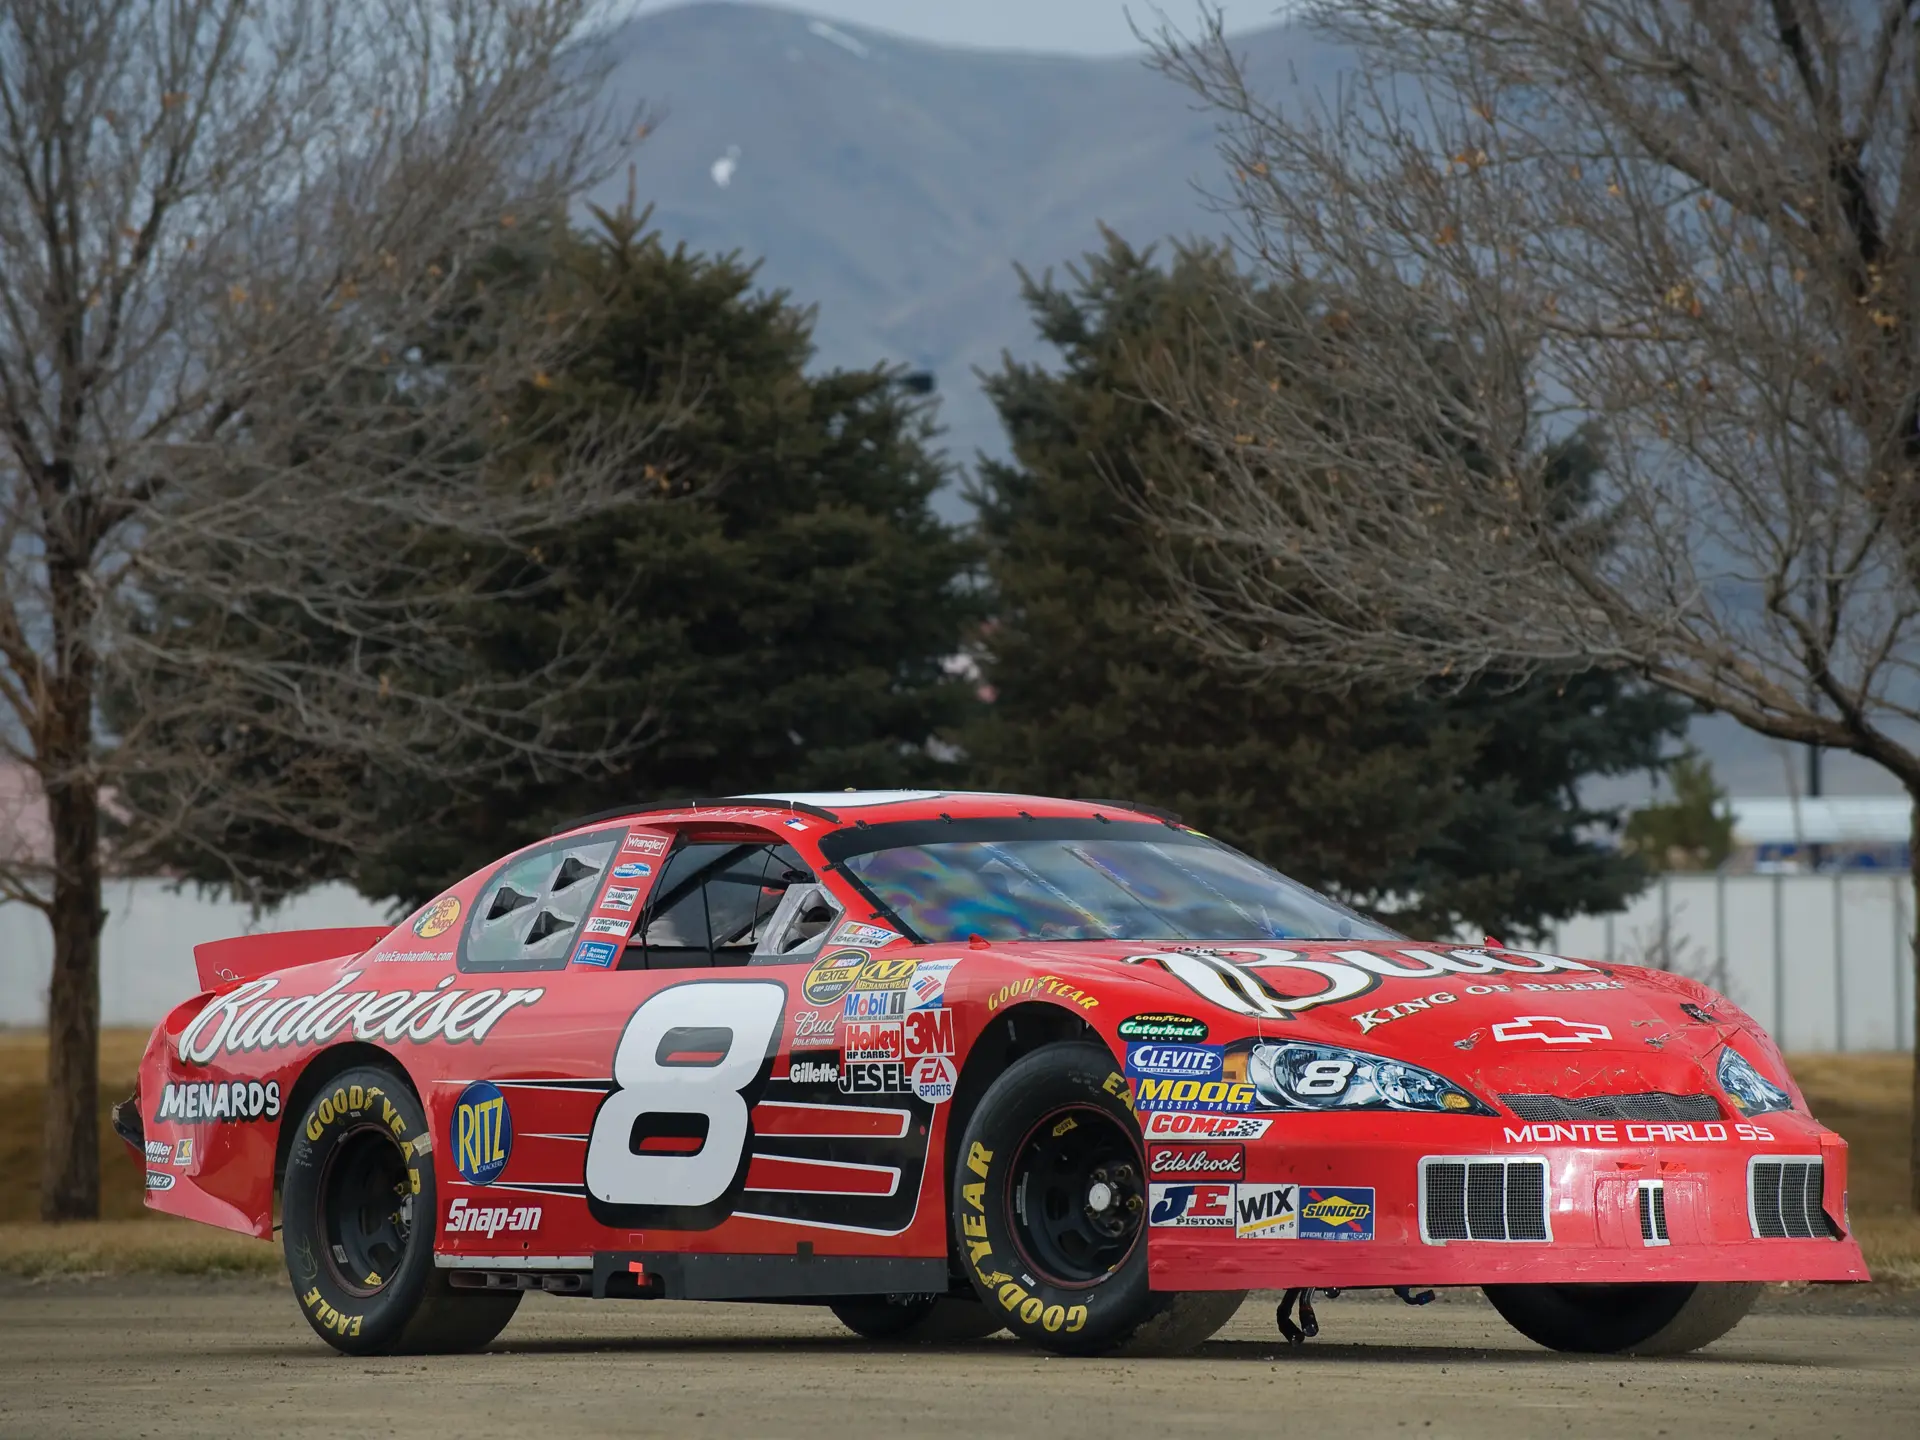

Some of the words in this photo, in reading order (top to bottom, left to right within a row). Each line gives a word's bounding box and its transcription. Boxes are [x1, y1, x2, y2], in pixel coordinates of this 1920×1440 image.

[628, 836, 664, 852] Wrangler
[608, 892, 635, 901] CHAMPION
[595, 918, 630, 929] CINCINNATI
[834, 935, 856, 943] RACE
[858, 937, 882, 946] CAR
[814, 968, 849, 983] NEXTEL
[855, 980, 889, 990] MECHANIX
[890, 978, 910, 988] WEAR
[1126, 946, 1606, 1019] Bud
[812, 985, 823, 993] CUP
[823, 984, 842, 992] SERIES
[988, 975, 1100, 1012] GOODYEAR
[844, 992, 888, 1016] Mobil
[892, 992, 905, 1015] 1
[1351, 991, 1458, 1035] KING
[1465, 984, 1511, 995] OF
[177, 970, 545, 1065] Budweiser
[794, 1010, 841, 1037] Bud
[1120, 1021, 1204, 1036] Gatorback
[1135, 1015, 1194, 1023] GOODYEAR
[846, 1024, 900, 1058] Holley
[905, 1010, 954, 1055] 3M
[847, 1052, 859, 1060] HP
[860, 1050, 891, 1059] CARBS
[1133, 1045, 1216, 1069] CLEVITE
[789, 1063, 838, 1083] Gillette
[839, 1063, 913, 1092] JESEL
[920, 1058, 950, 1083] EA
[1295, 1060, 1356, 1096] 8
[157, 1080, 281, 1121] MENARDS
[583, 980, 787, 1208] 8
[919, 1084, 952, 1097] SPORTS
[1136, 1078, 1257, 1104] MOOG
[1141, 1100, 1198, 1110] CHASSIS
[1207, 1101, 1250, 1111] PARTS
[458, 1096, 505, 1175] RITZ
[1151, 1113, 1239, 1134] COMP
[1503, 1123, 1619, 1144] MONTE
[1625, 1123, 1728, 1143] CARLO
[1735, 1123, 1775, 1142] SS
[479, 1160, 504, 1173] CRACKERS
[1150, 1150, 1242, 1173] Edelbrock
[1150, 1184, 1230, 1224] JE
[1238, 1186, 1295, 1224] WIX
[1305, 1203, 1369, 1219] SUNOCO
[444, 1198, 542, 1239] Snap-on
[1175, 1216, 1234, 1226] PISTONS
[962, 1140, 1088, 1334] GOODYEAR
[1323, 1231, 1336, 1239] FUEL
[302, 1286, 364, 1337] EAGLE
